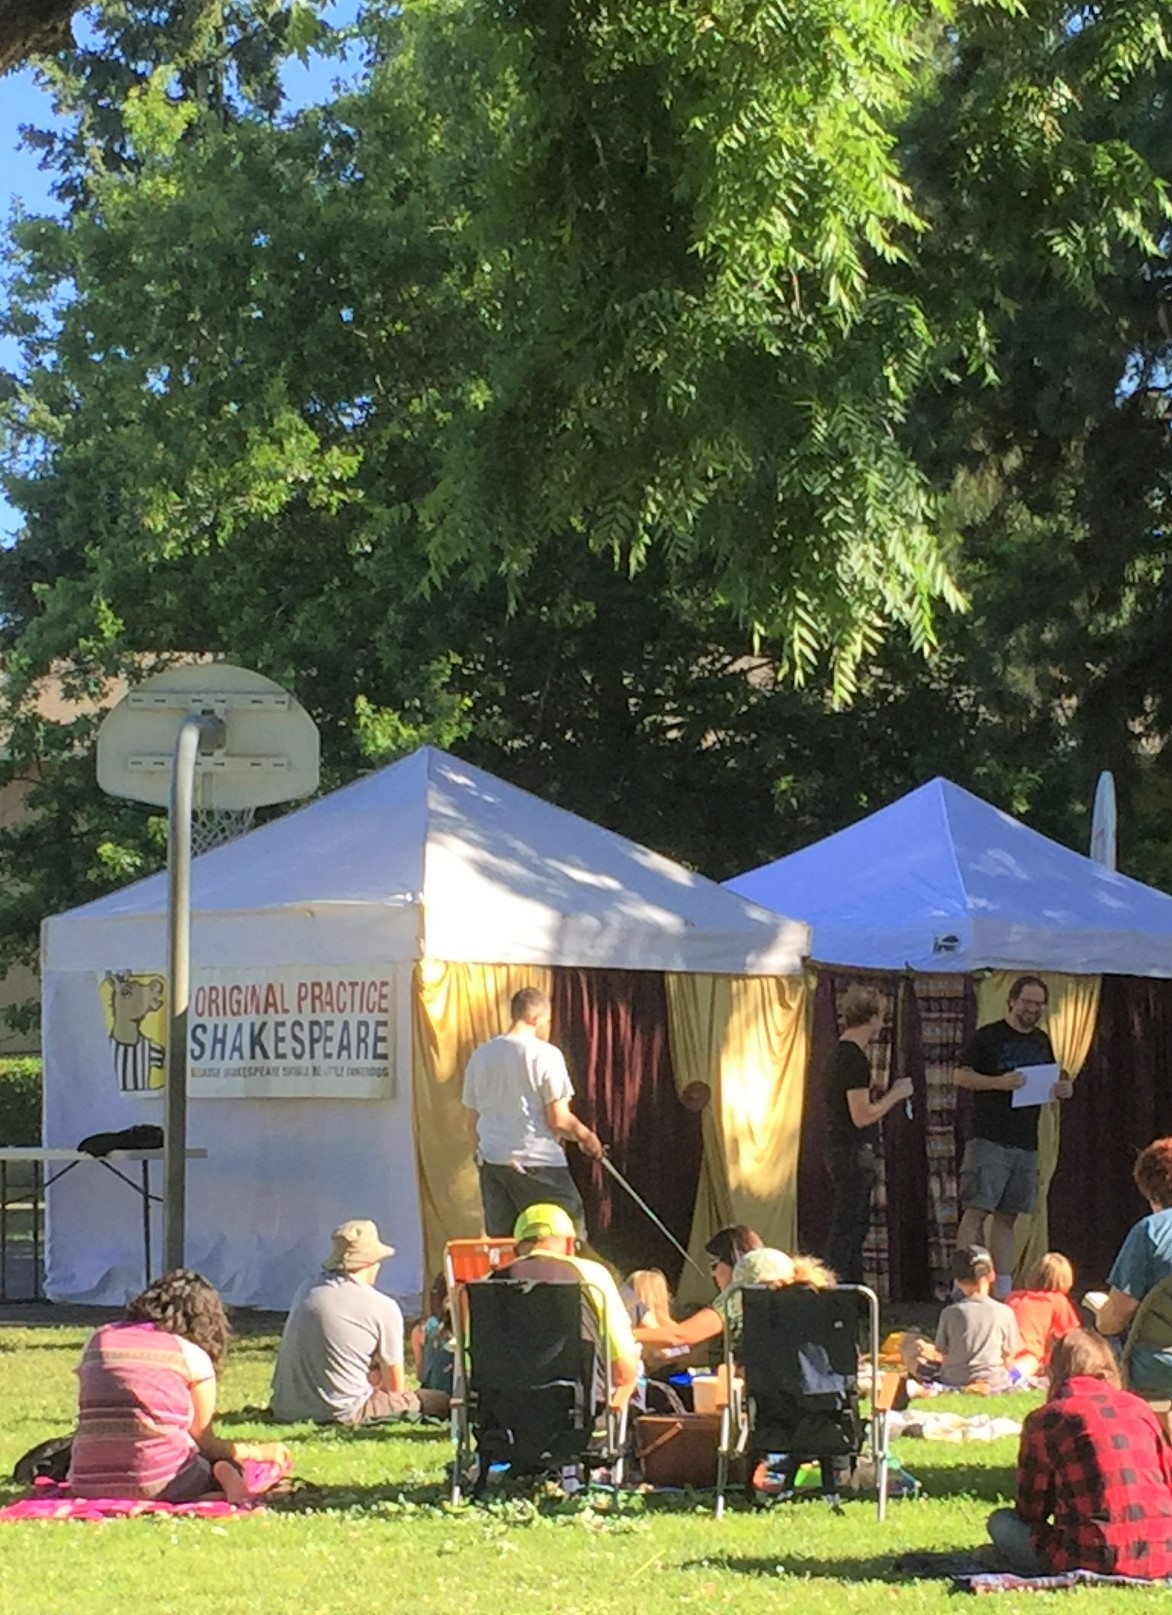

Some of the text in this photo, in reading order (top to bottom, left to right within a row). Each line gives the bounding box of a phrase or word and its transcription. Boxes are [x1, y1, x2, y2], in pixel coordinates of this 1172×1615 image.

[195, 980, 390, 1018] ORIGINAL PRACTICE
[190, 1020, 389, 1061] SHAKESPEARE
